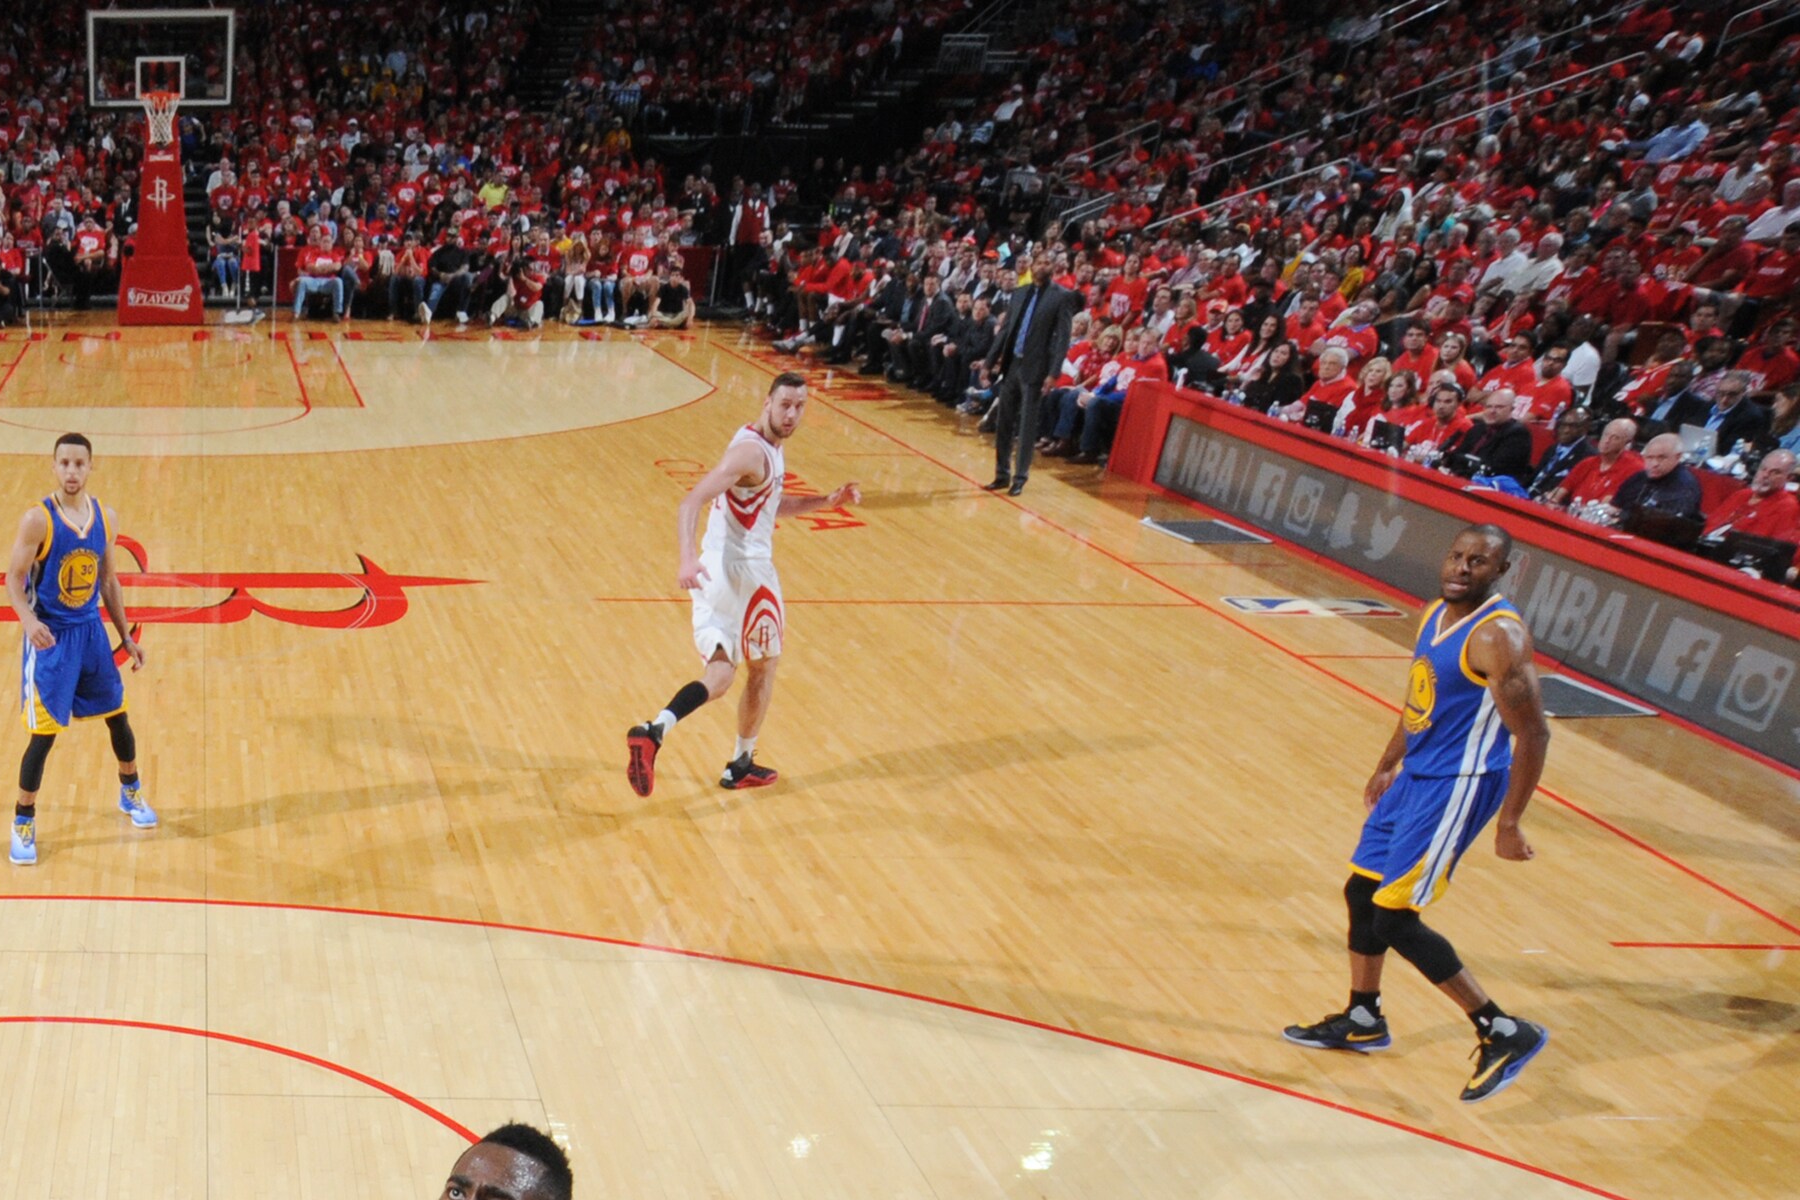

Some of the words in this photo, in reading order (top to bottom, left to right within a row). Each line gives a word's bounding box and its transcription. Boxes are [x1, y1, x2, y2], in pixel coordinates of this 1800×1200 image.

[135, 289, 191, 306] PLAYOFFS
[1178, 433, 1238, 502] NBA
[80, 564, 94, 576] 30
[1523, 564, 1629, 669] NBA
